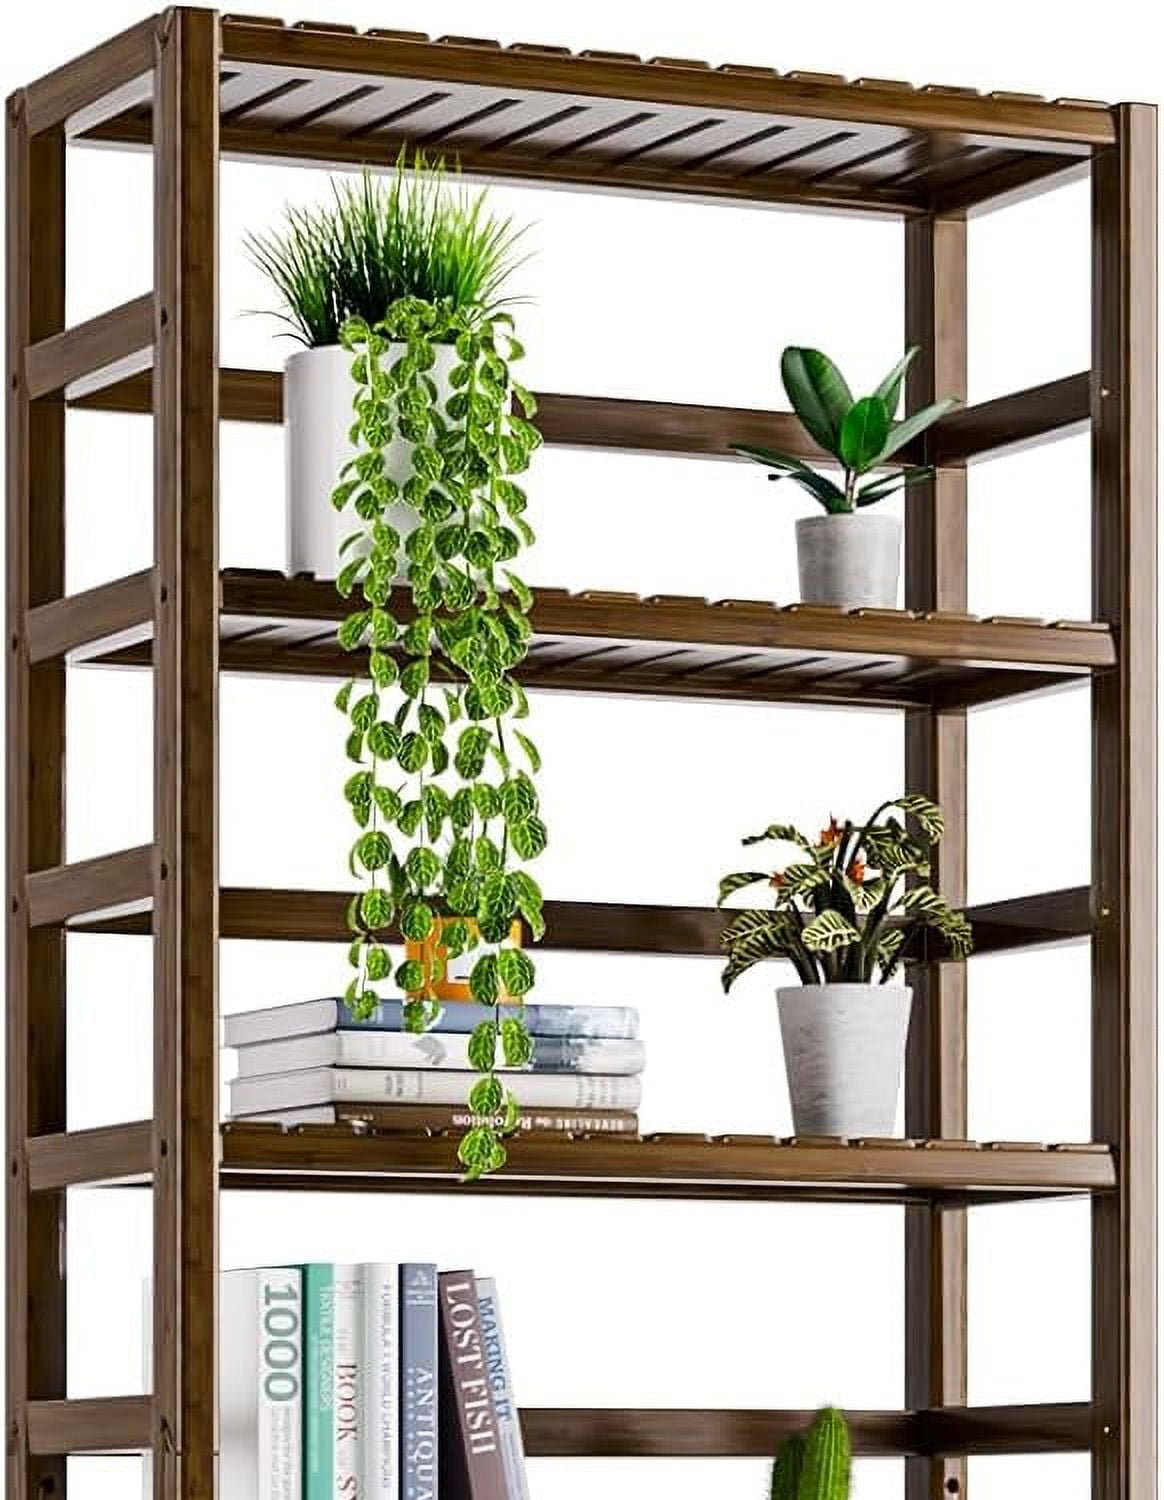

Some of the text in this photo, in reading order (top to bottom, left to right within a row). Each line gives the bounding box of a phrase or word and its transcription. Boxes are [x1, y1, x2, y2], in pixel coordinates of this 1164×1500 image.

[264, 1284, 299, 1401] 1000
[336, 1364, 358, 1440] BOOK
[446, 1282, 497, 1455] LOST FISH
[479, 1295, 513, 1423] MAKING IT
